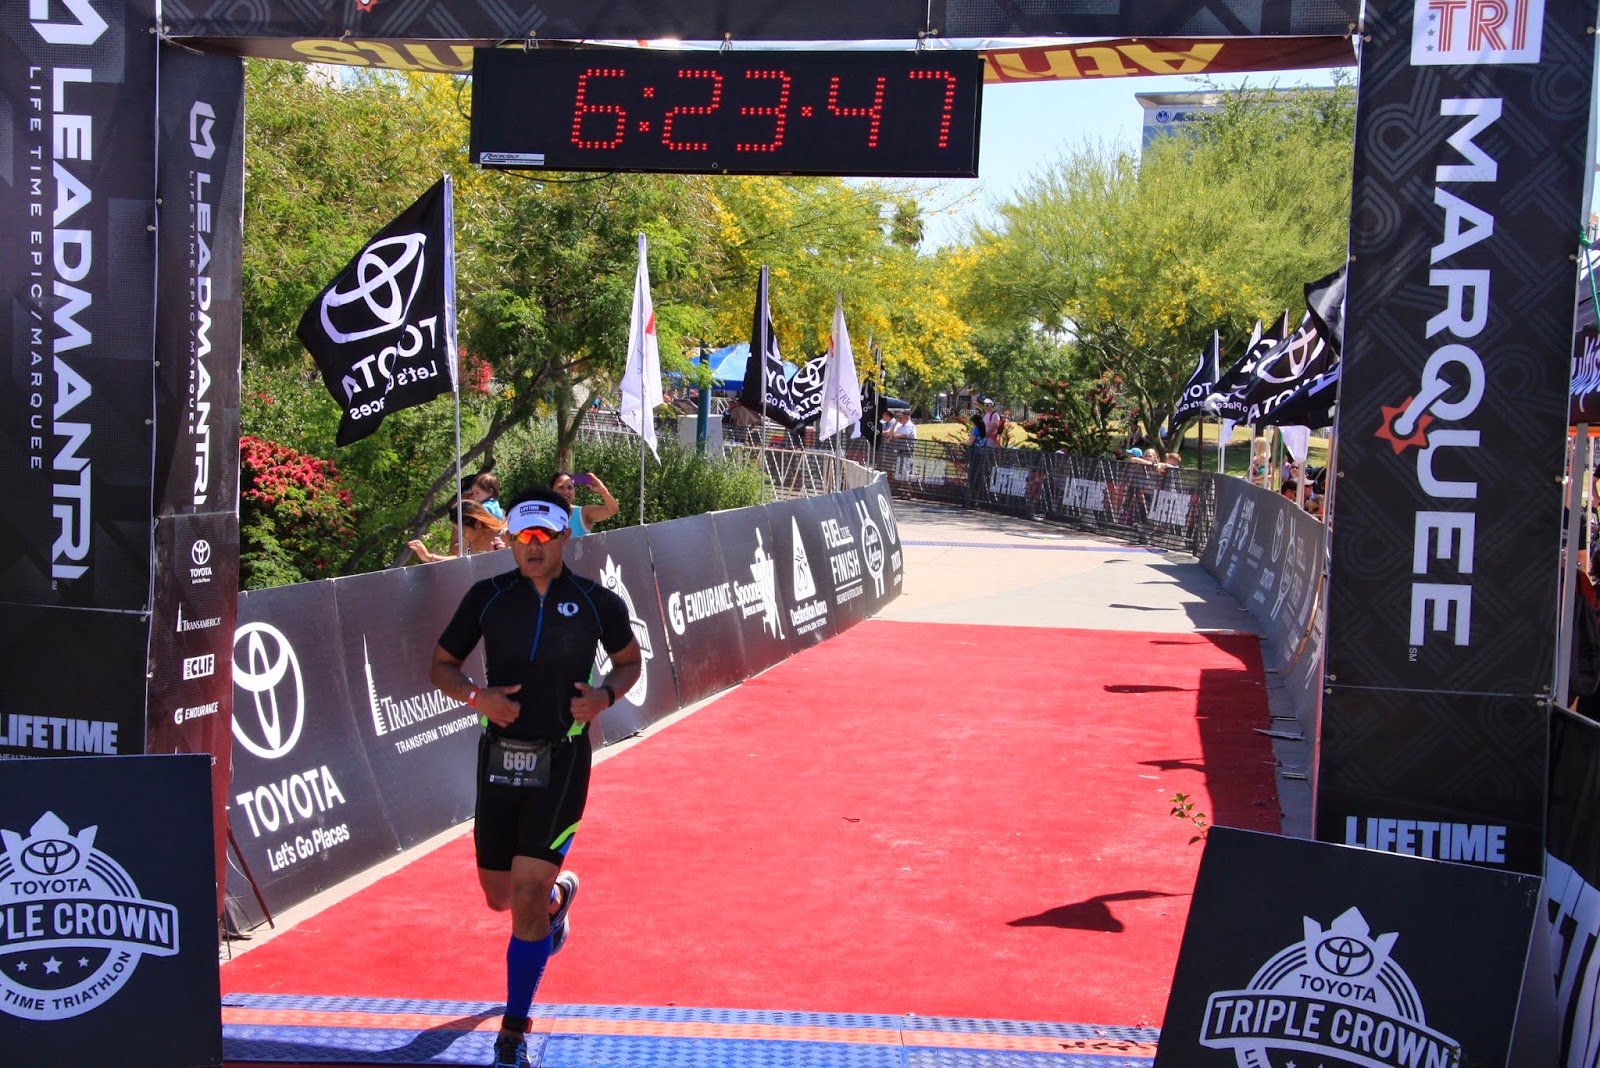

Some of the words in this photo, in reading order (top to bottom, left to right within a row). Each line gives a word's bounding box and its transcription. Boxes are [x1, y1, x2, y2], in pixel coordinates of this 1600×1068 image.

[1429, 0, 1528, 52] TRI
[29, 65, 42, 132] LIFE
[29, 146, 42, 217] TIME
[52, 66, 93, 580] LEADMANTRI
[193, 171, 212, 505] LEADMANTRI
[1394, 97, 1503, 647] MARQUEE
[189, 567, 213, 578] TOYOTA
[830, 548, 862, 585] FINISH
[182, 617, 221, 632] TRANSAMERICA
[684, 582, 734, 624] ENDURANCE
[191, 656, 213, 677] CLIF
[184, 701, 219, 721] ENDURANCE
[395, 730, 438, 755] TRANSFORM
[438, 713, 479, 738] TOMORROW
[503, 751, 537, 772] 660
[235, 764, 346, 838] TOYOTA
[267, 840, 297, 872] Let's
[295, 834, 315, 862] Go
[312, 822, 350, 853] Places
[1345, 815, 1507, 864] LIFETIME
[11, 877, 92, 896] TOYOTA
[53, 902, 170, 945] CROWN
[4, 988, 45, 1011] TIME
[51, 951, 132, 1011] TRIATHLON
[1300, 973, 1377, 1004] TOYOTA
[1214, 998, 1325, 1040] TRIPLE
[1329, 1008, 1456, 1068] CROWN
